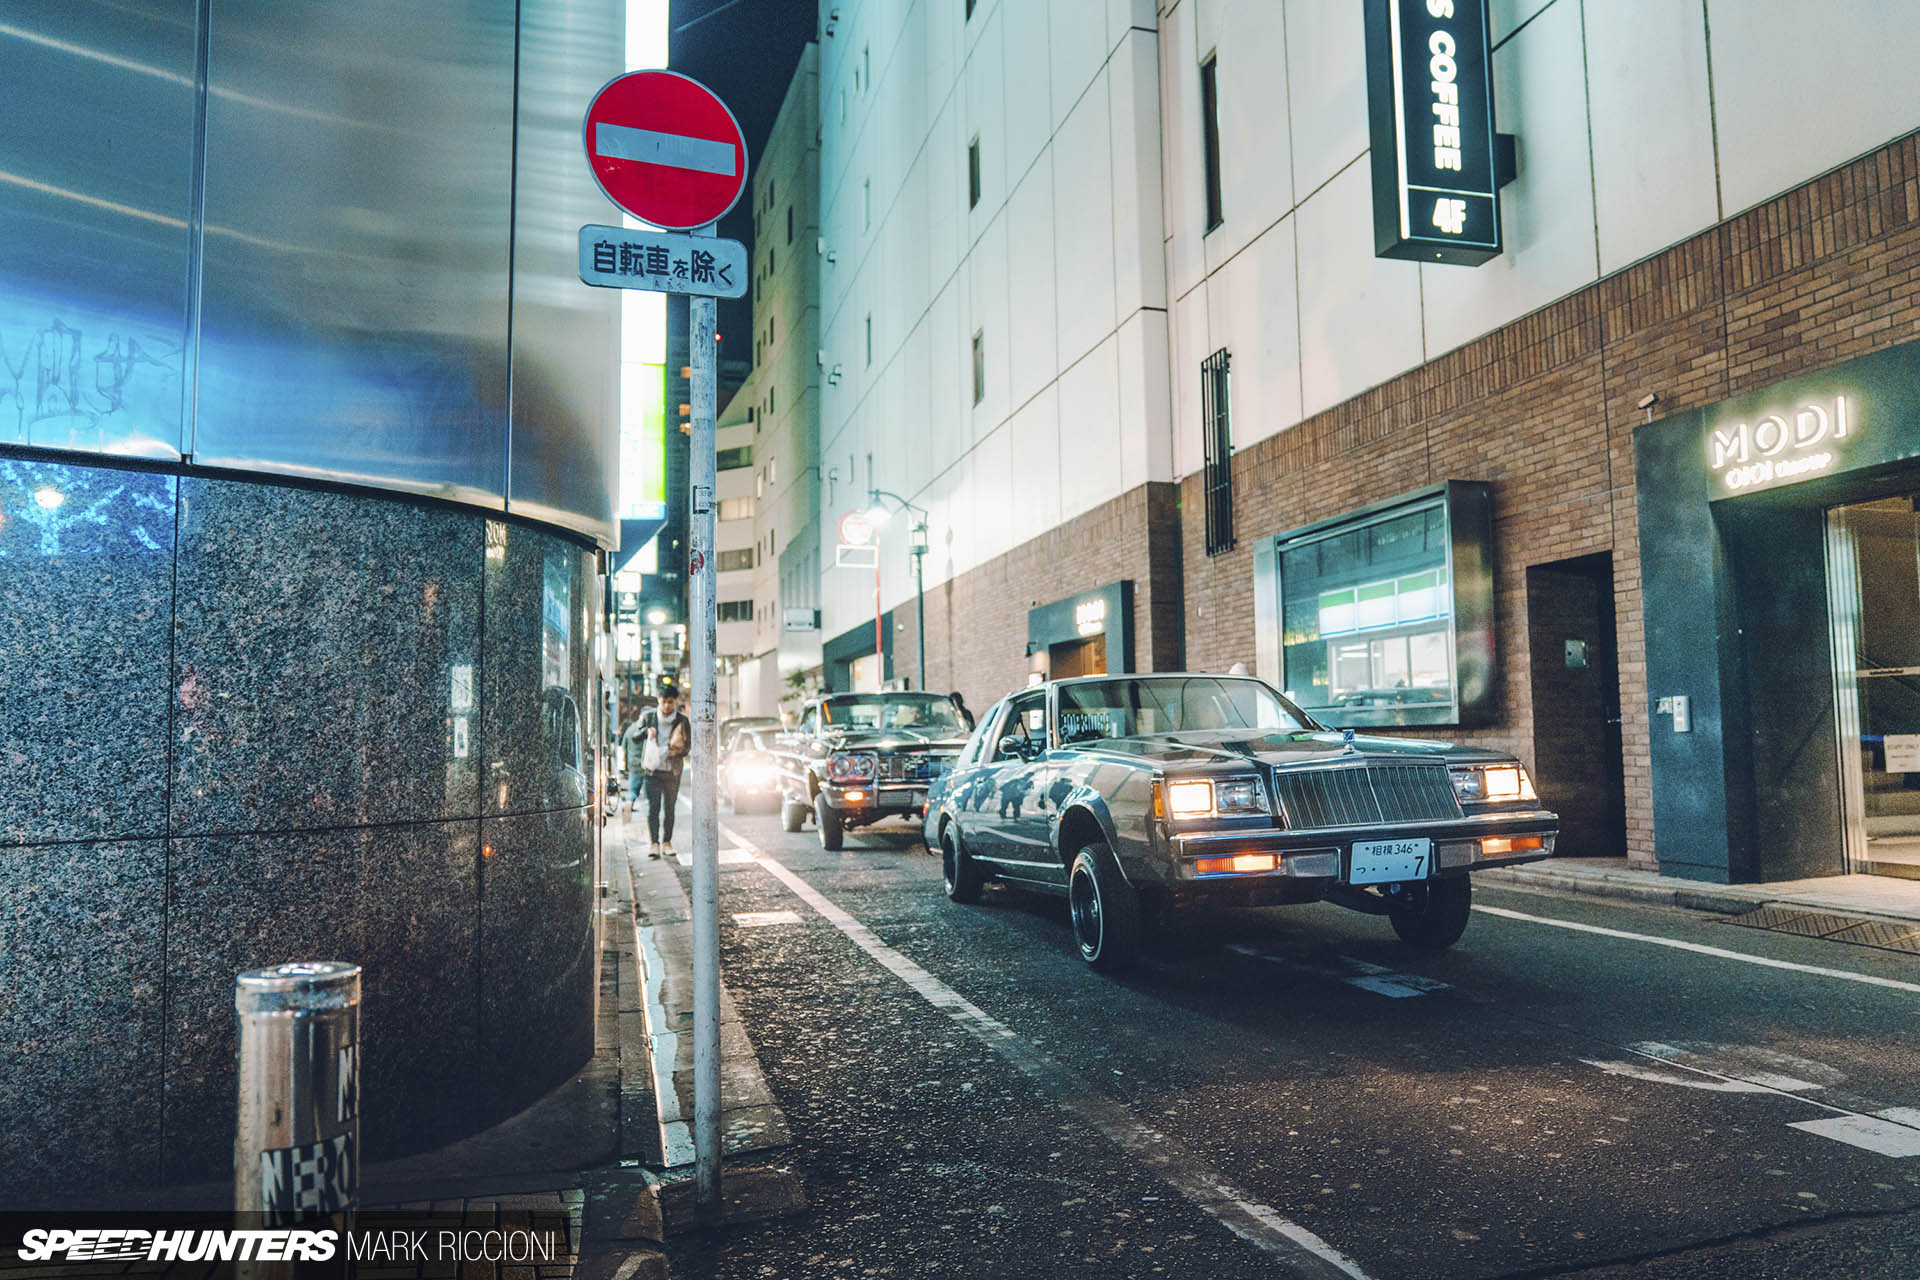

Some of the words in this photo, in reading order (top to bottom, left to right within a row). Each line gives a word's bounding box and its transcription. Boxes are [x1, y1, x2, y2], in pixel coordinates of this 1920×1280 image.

[1429, 30, 1462, 171] COFFEE
[1432, 198, 1466, 234] 4F
[592, 239, 733, 286] 自転車を除く
[1712, 395, 1848, 469] MODI
